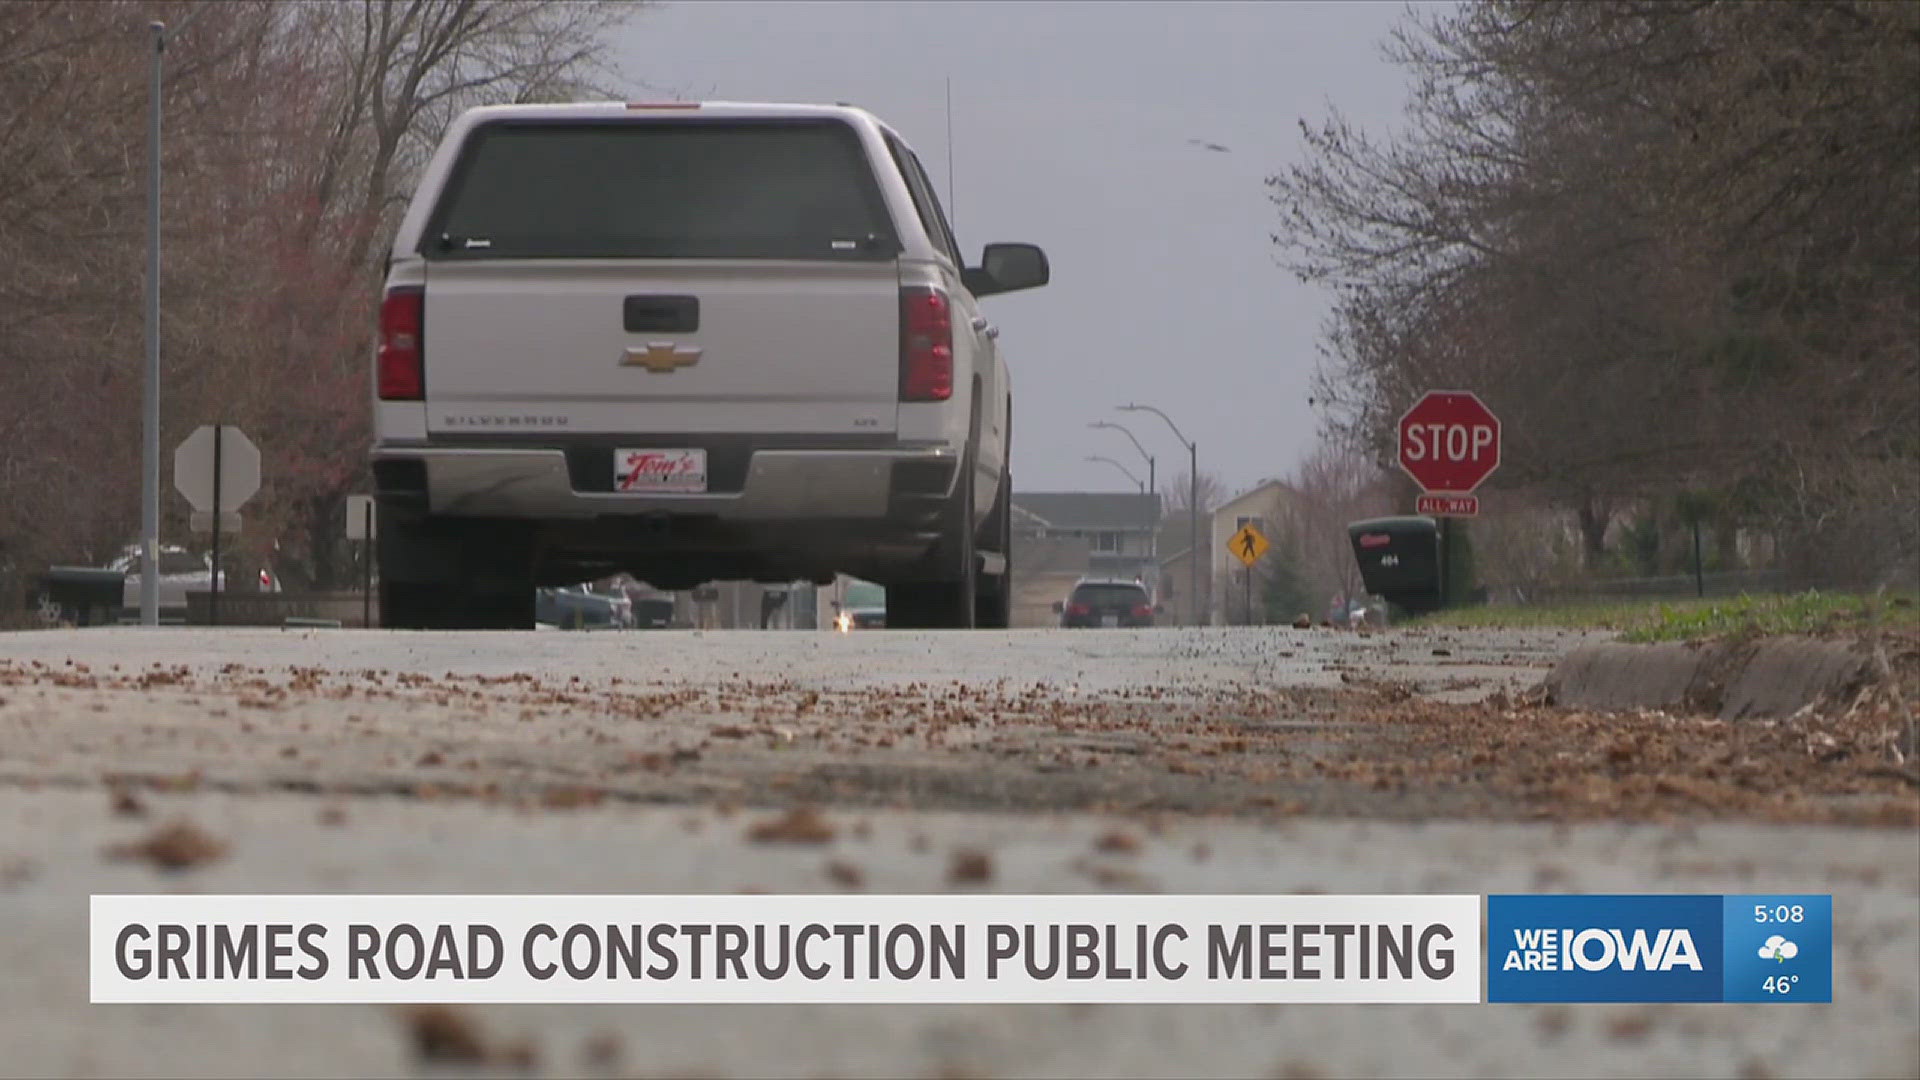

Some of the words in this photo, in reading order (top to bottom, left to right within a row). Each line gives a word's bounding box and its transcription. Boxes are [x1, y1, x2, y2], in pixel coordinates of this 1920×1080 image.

[1405, 423, 1493, 461] STOP
[1422, 500, 1441, 513] ALL
[1449, 500, 1473, 513] WAY
